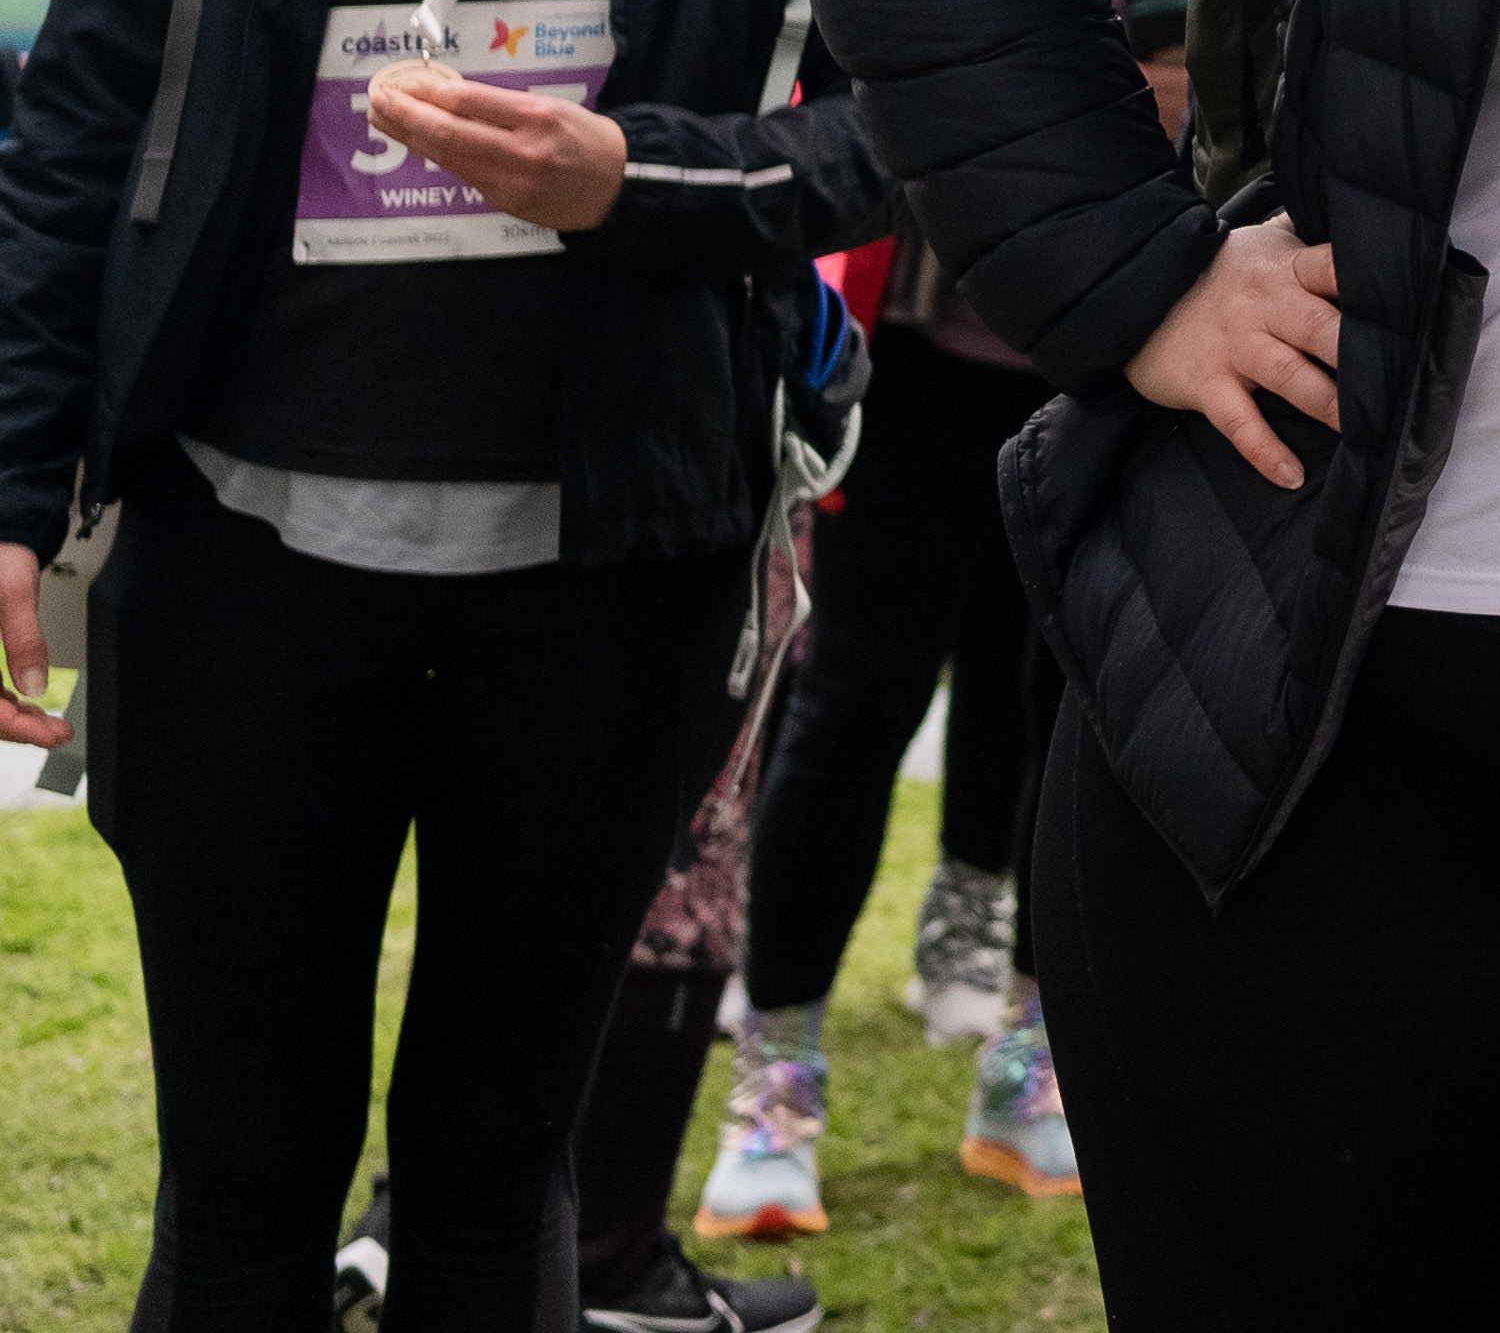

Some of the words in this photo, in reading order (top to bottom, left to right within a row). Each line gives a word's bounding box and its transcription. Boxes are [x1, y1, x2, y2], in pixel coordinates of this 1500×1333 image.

[535, 21, 606, 41] Beyond
[535, 41, 575, 57] Blue
[380, 187, 458, 208] WINEY
